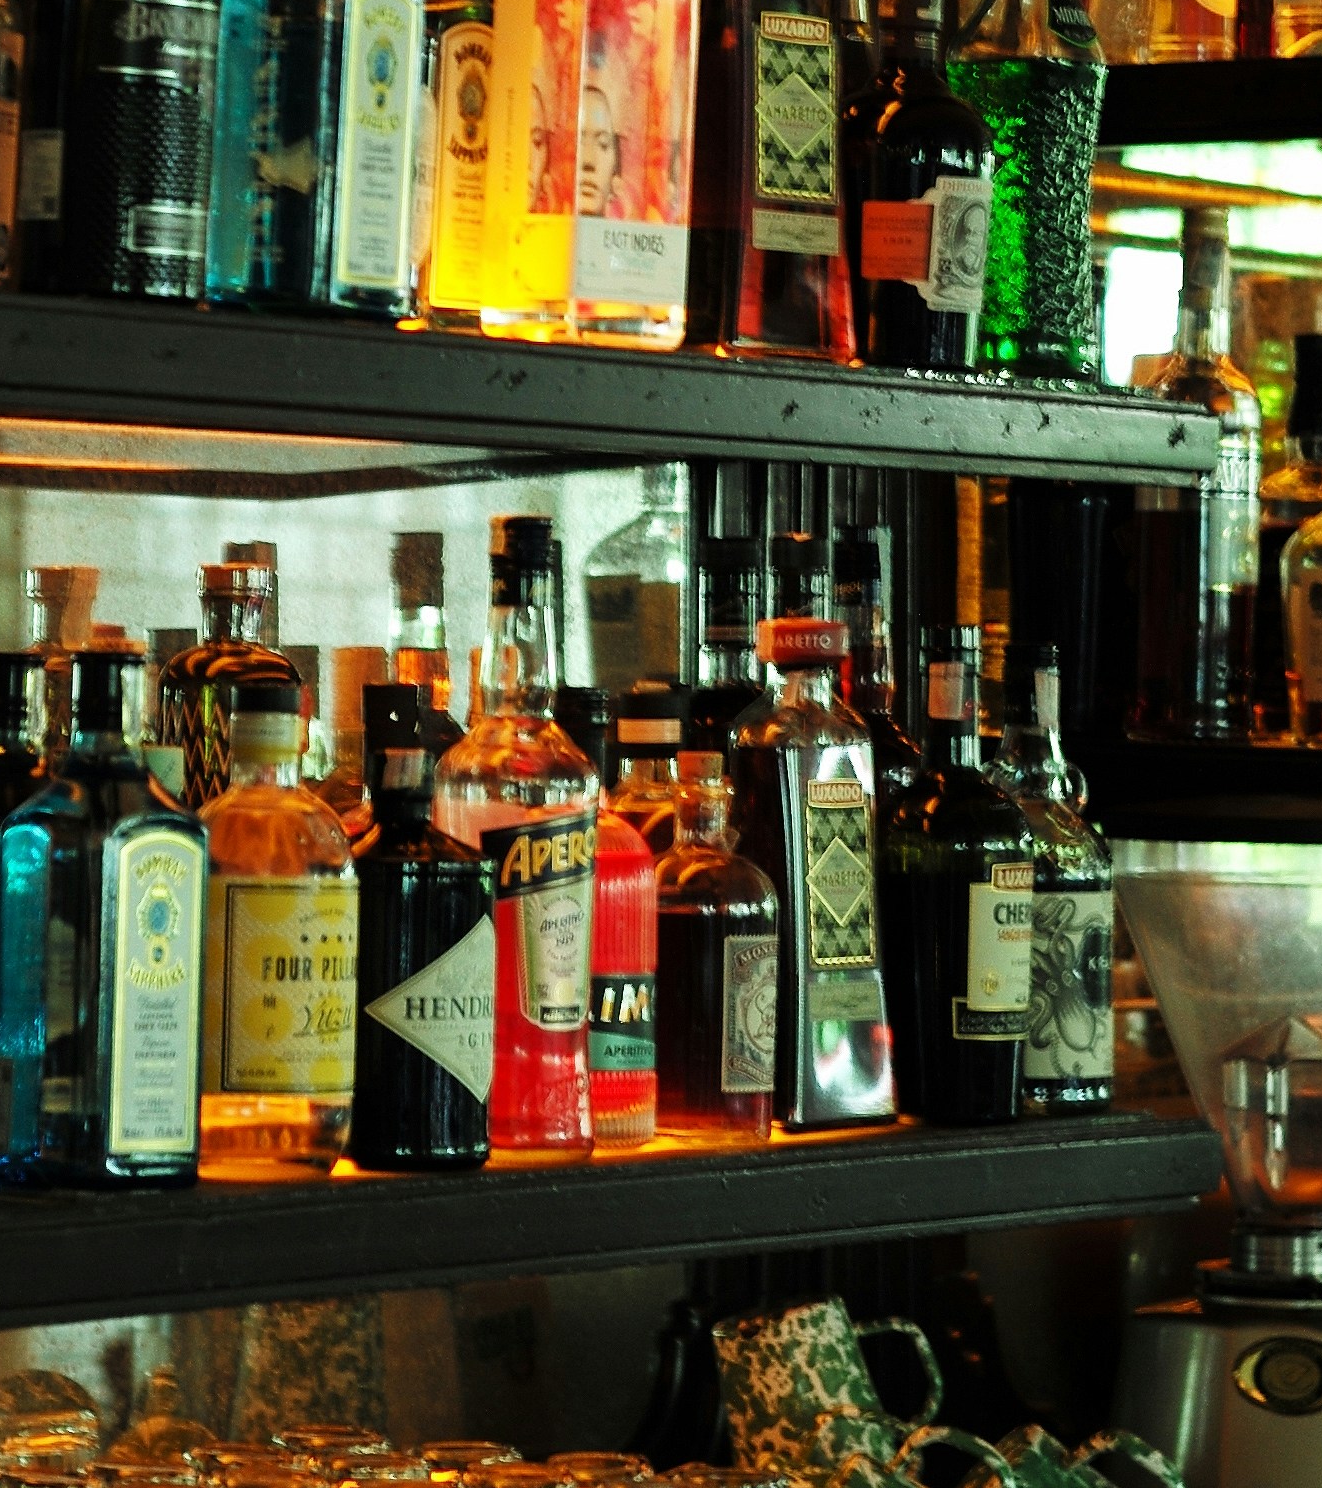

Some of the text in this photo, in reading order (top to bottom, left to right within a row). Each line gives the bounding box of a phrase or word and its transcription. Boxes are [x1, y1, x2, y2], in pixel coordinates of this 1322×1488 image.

[764, 15, 826, 41] LUXARDO
[766, 104, 827, 124] AMARETTO
[811, 782, 862, 803] LUXARDO
[131, 853, 190, 889] BOMBAY
[127, 956, 186, 992] SAPPHIRE
[261, 955, 312, 982] FOUR
